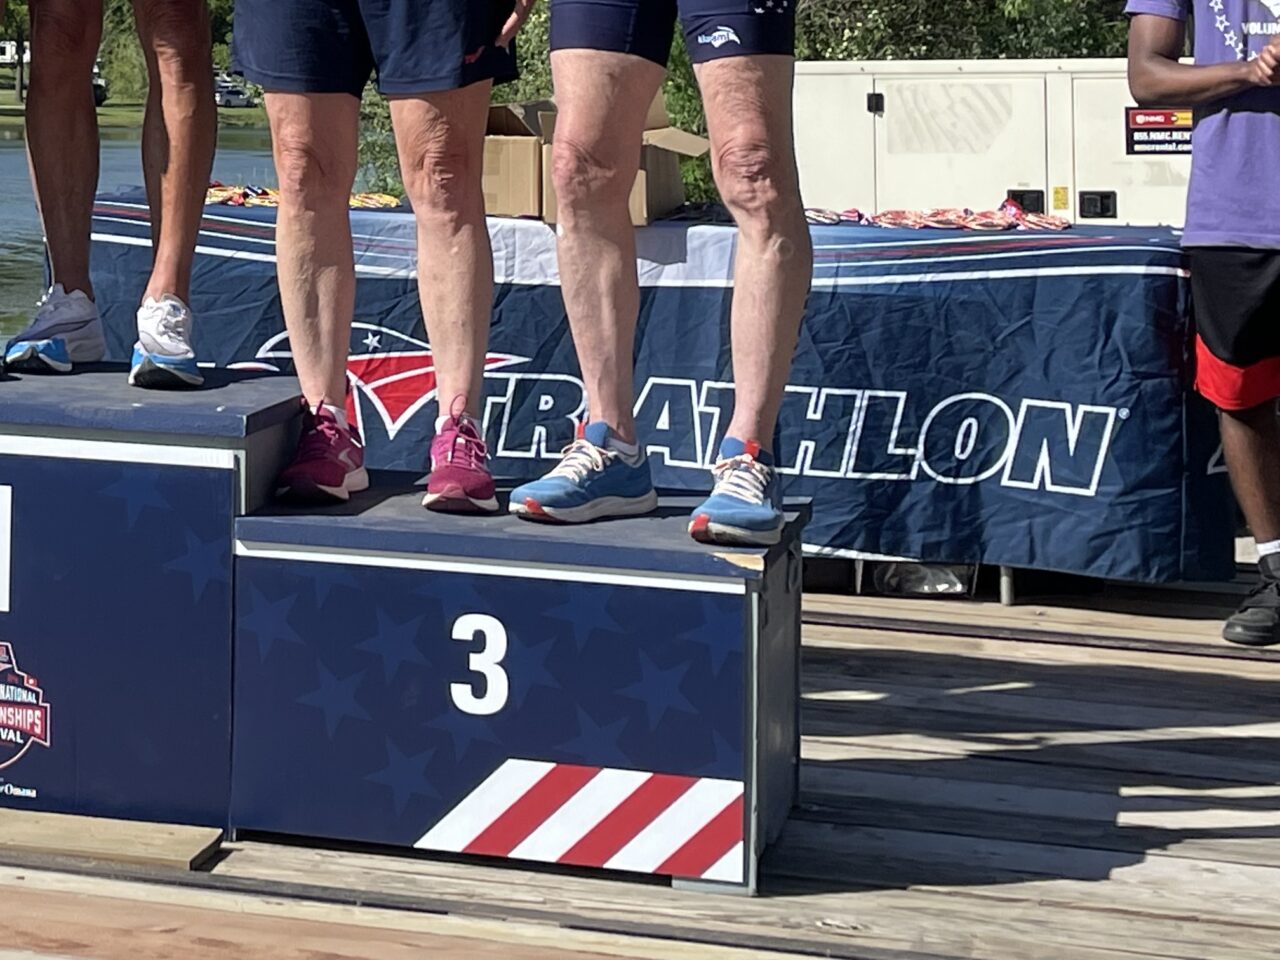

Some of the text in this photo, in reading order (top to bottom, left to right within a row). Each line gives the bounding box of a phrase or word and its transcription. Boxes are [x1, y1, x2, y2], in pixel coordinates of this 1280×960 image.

[482, 372, 1117, 497] TRATHLON
[0, 684, 38, 704] NATIONAL
[449, 614, 510, 716] 3
